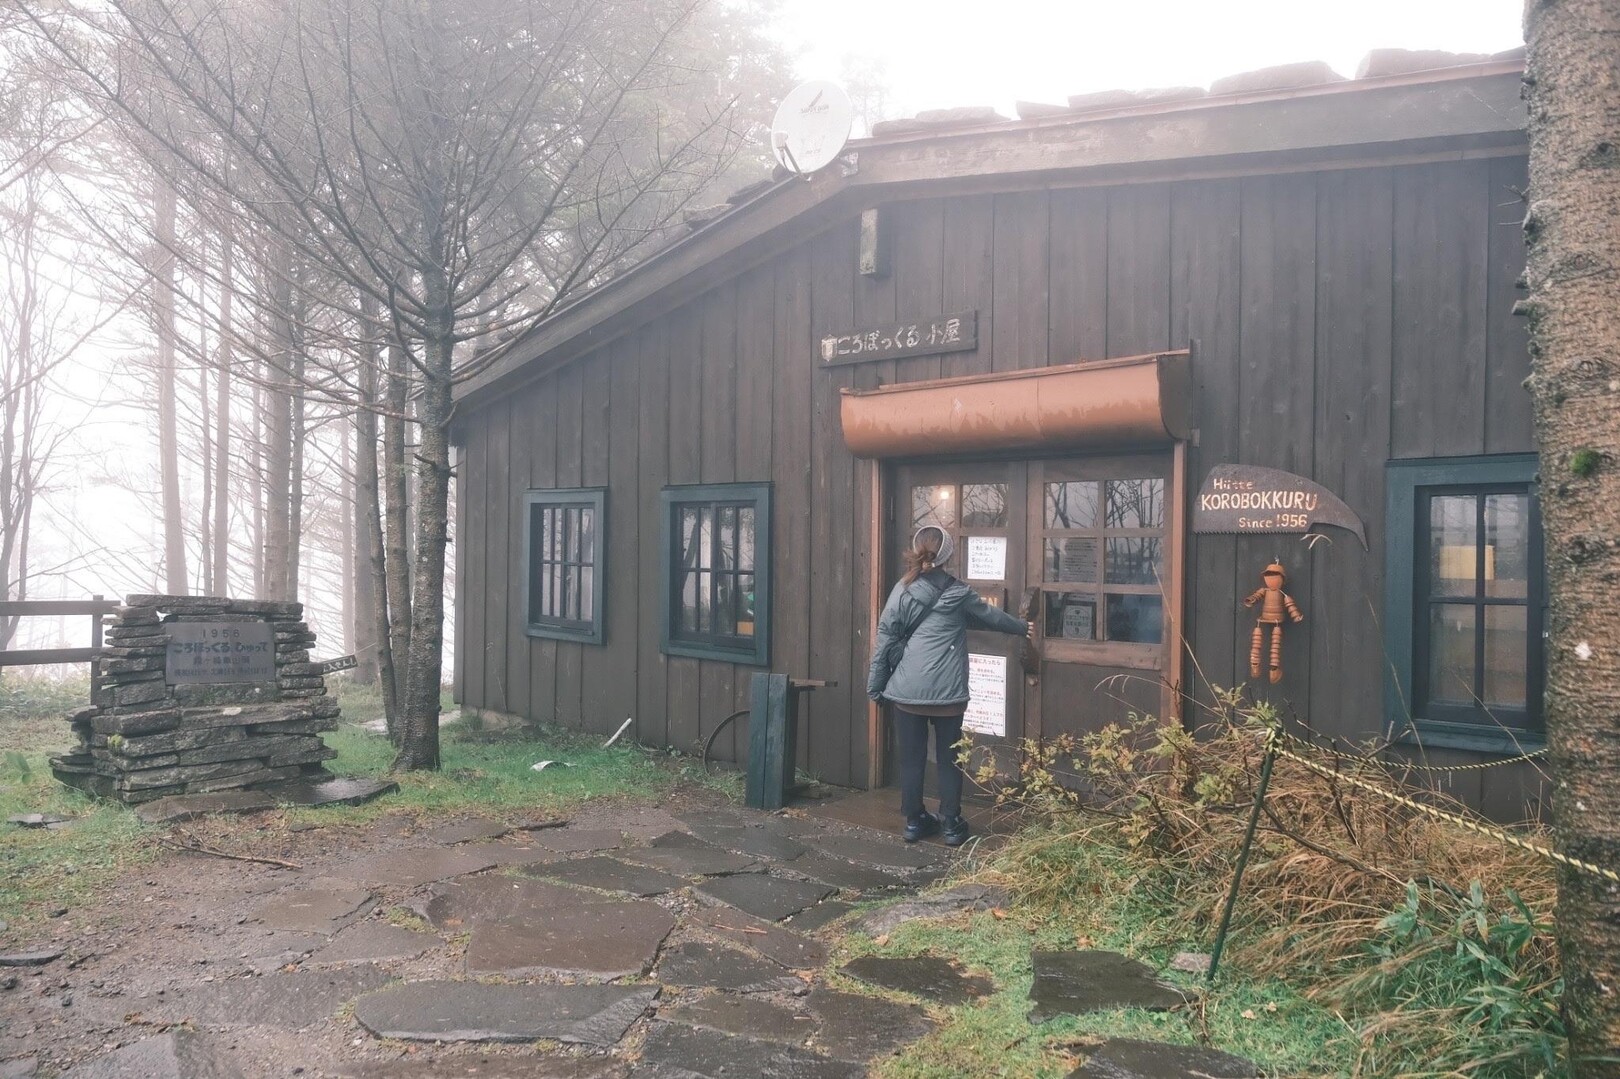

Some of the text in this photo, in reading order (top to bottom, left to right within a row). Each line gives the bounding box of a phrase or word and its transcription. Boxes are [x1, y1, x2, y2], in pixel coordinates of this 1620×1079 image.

[1201, 491, 1318, 511] KOROBOKKURU
[1238, 514, 1308, 529] Since 1956
[202, 629, 240, 638] 1956
